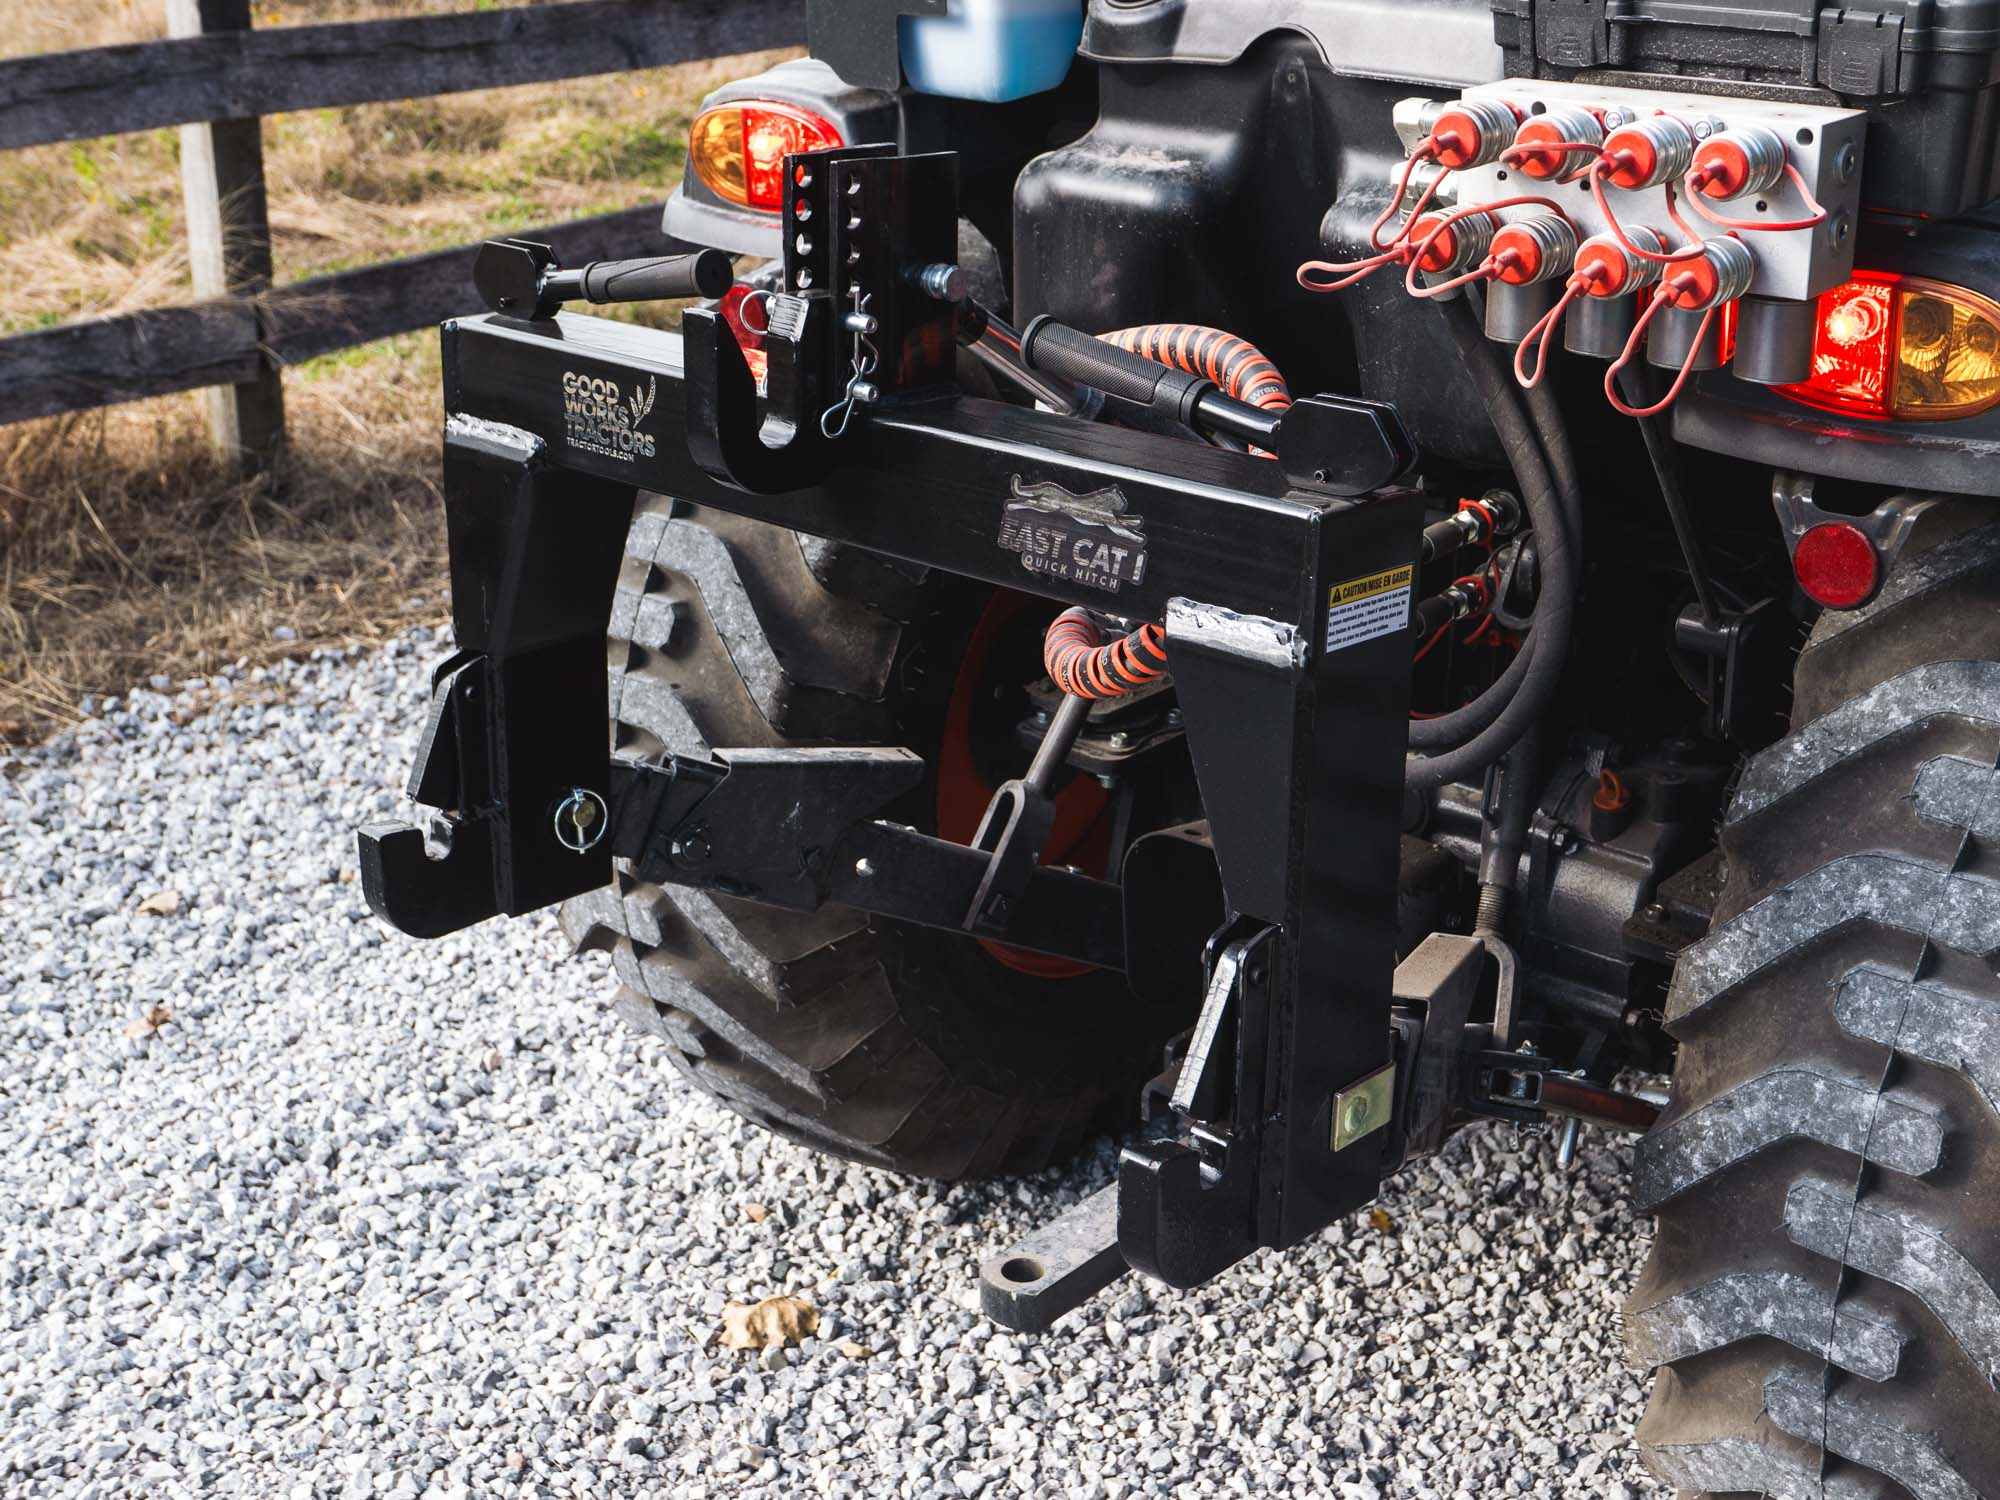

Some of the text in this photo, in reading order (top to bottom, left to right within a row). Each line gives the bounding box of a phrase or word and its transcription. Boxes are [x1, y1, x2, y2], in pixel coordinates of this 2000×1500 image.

[562, 371, 620, 405] GOOD
[563, 391, 630, 429] WORKS
[564, 412, 656, 457] TRACTORS
[566, 436, 635, 462] TRACTORTOOLS.COM
[1024, 554, 1118, 590] QUICK HITCH
[1073, 538, 1129, 576] CAT
